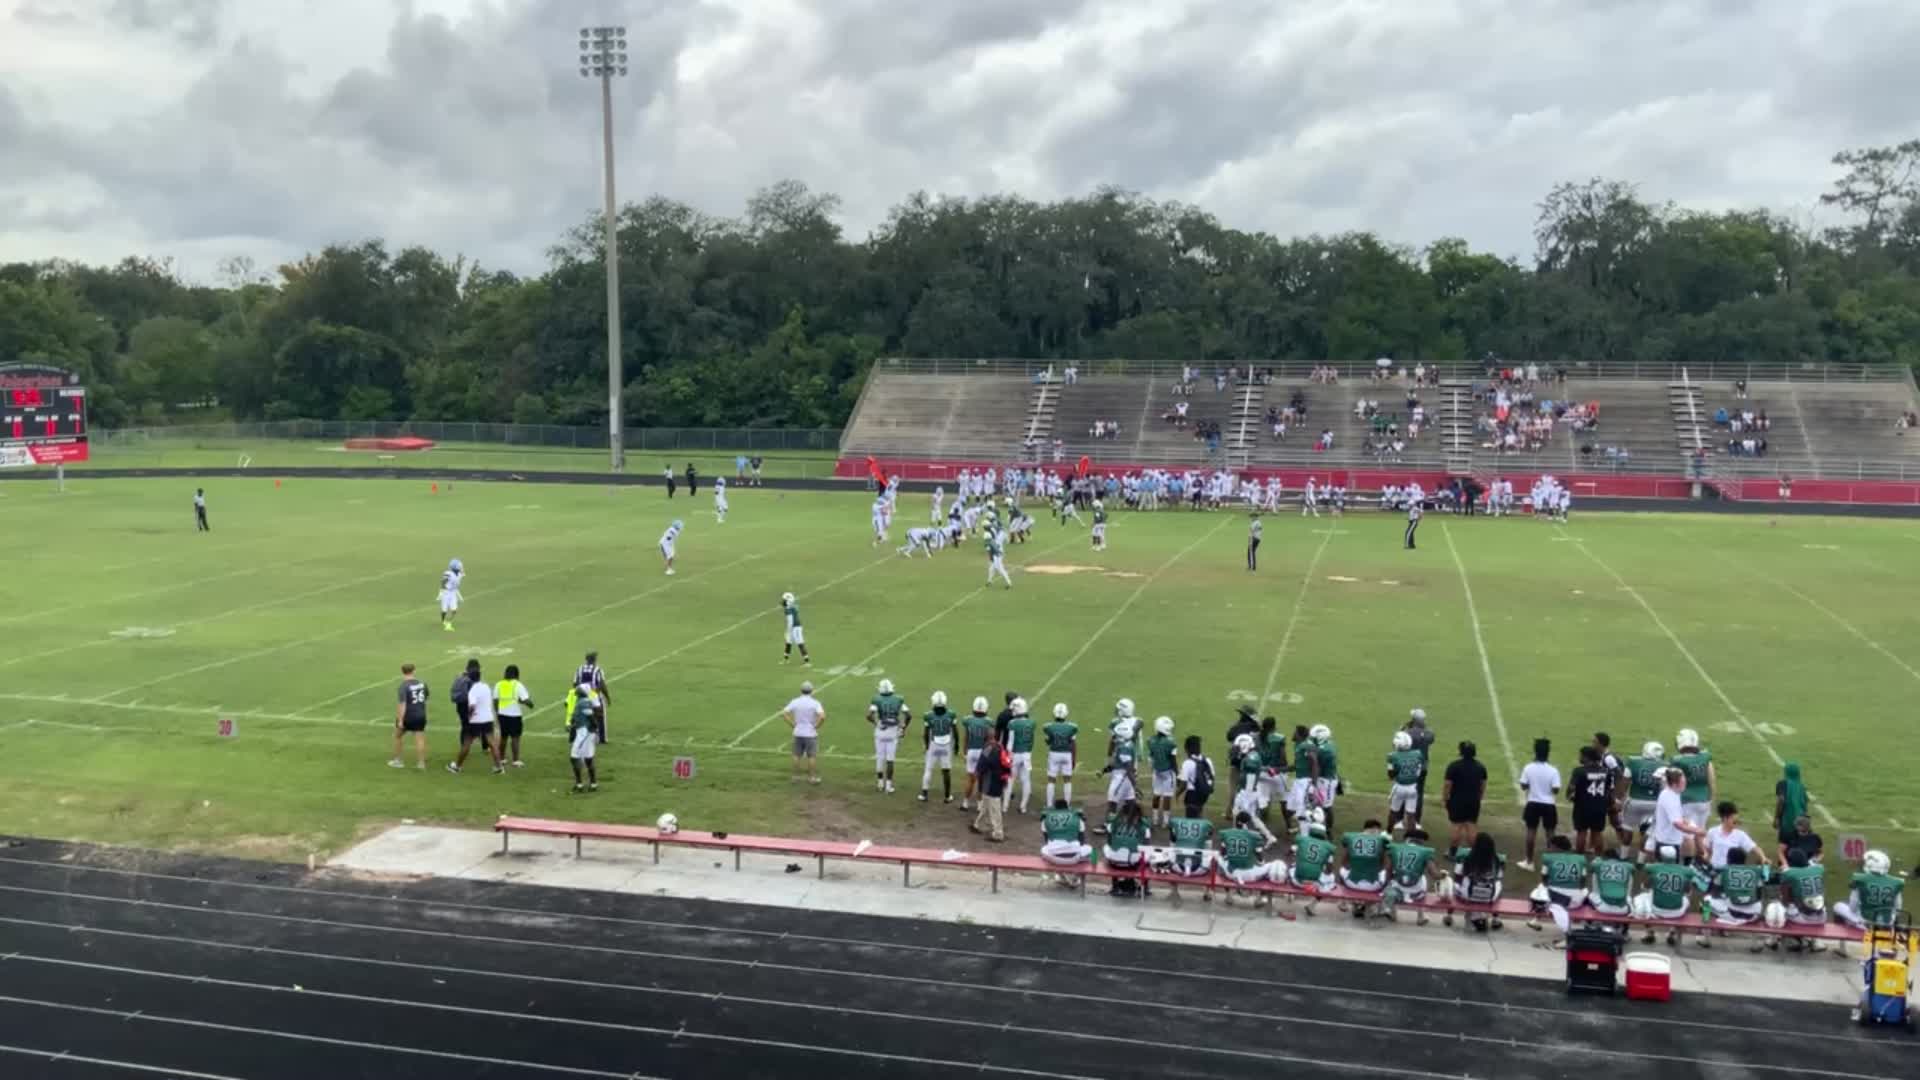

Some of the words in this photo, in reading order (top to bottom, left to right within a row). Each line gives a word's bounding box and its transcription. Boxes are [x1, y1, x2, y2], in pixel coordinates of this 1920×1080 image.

[411, 690, 425, 704] 56
[676, 760, 690, 777] 40
[1587, 781, 1605, 796] 44
[1226, 838, 1249, 857] 36
[1307, 844, 1319, 861] 5
[1354, 839, 1377, 857] 43
[1843, 839, 1866, 860] 40
[1398, 851, 1417, 869] 17
[1555, 862, 1578, 881] 24
[1601, 863, 1625, 881] 29
[1728, 868, 1755, 890] 52
[1657, 873, 1682, 892] 20
